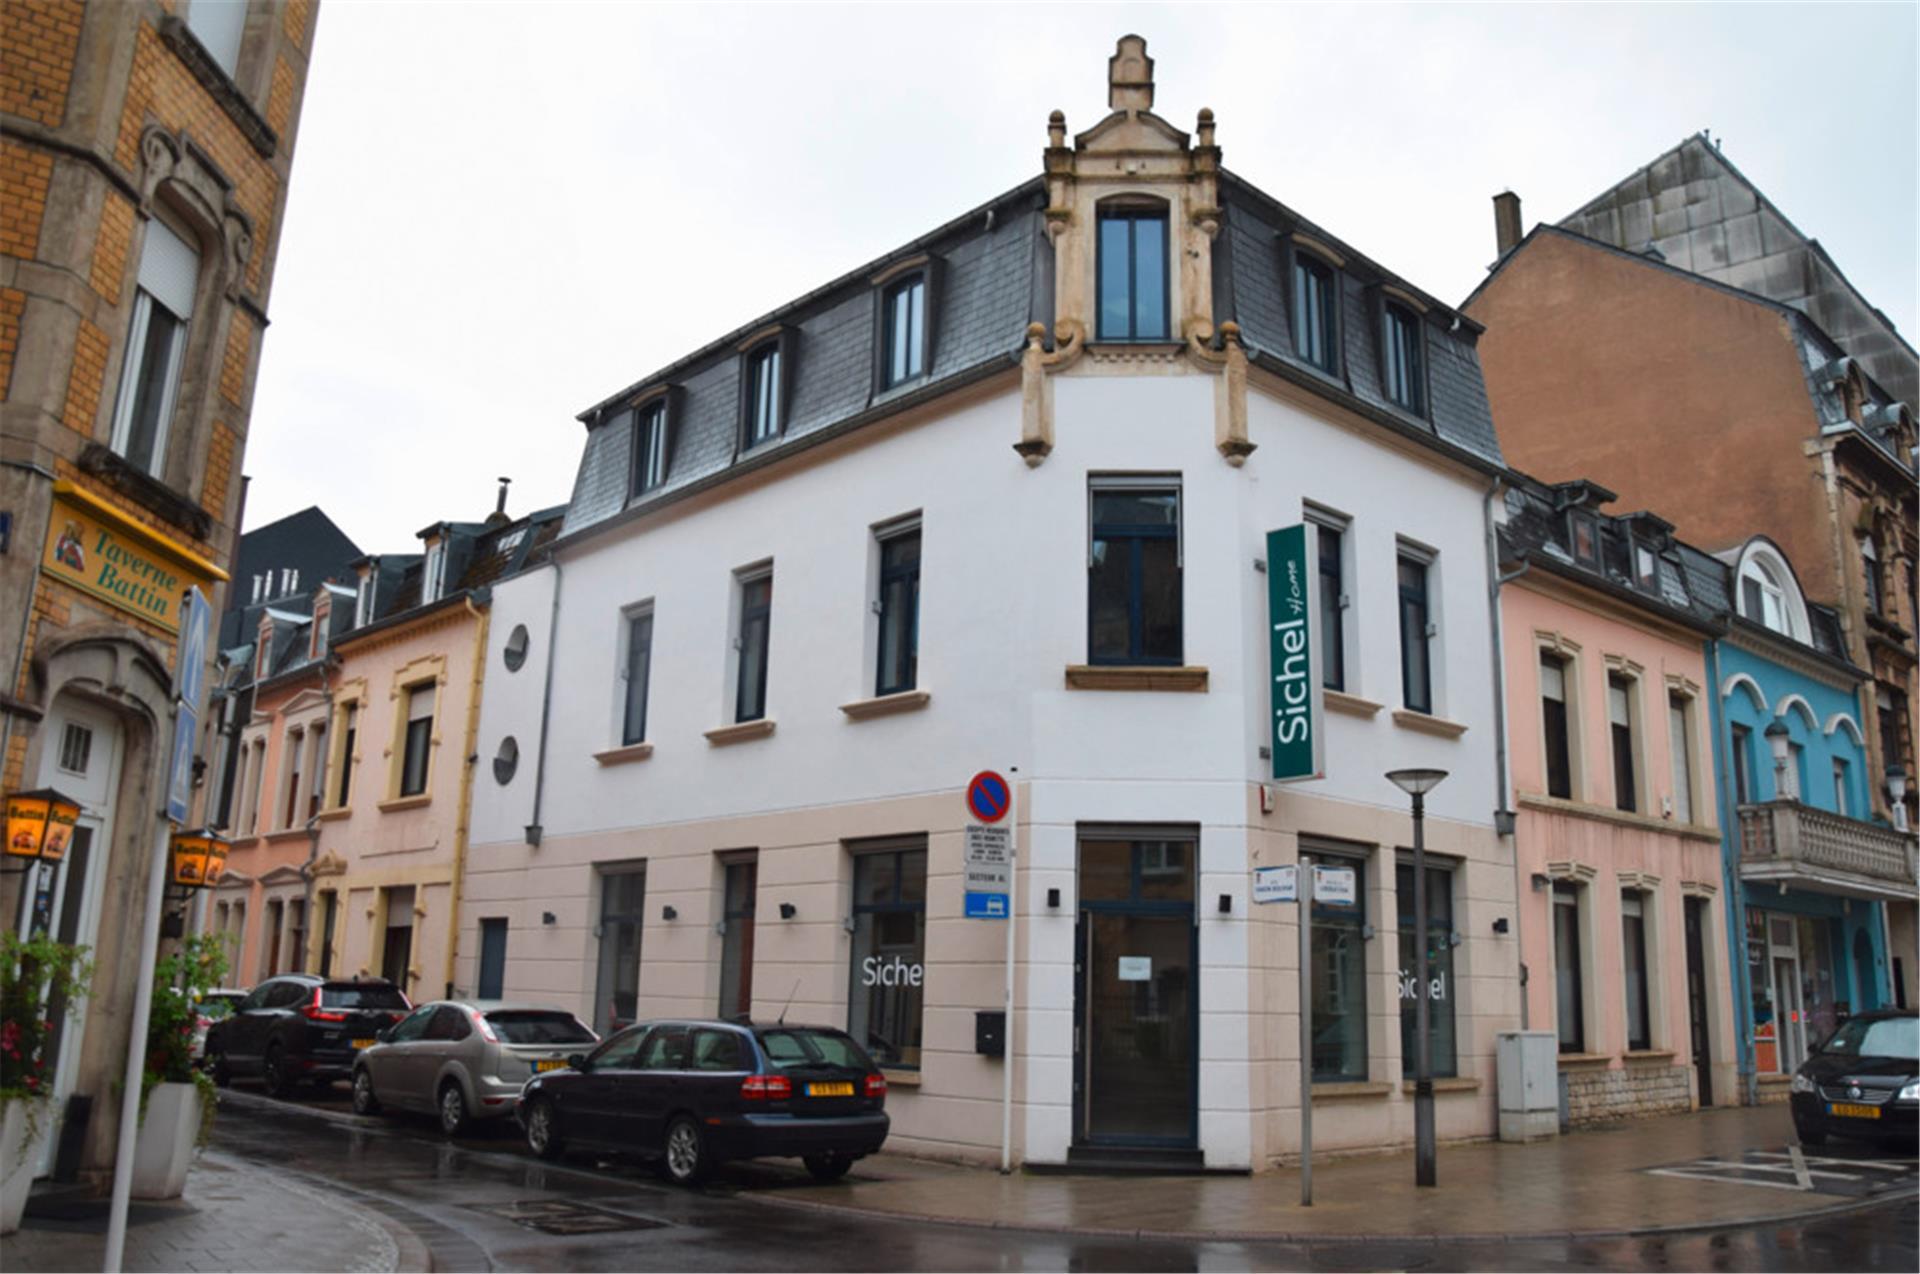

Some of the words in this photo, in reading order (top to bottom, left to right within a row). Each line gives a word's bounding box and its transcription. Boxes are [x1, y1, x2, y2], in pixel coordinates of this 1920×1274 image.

[94, 527, 178, 592] Taverne
[97, 563, 169, 616] Battin
[1274, 618, 1309, 744] Sichel
[1396, 969, 1446, 1000] Sicel
